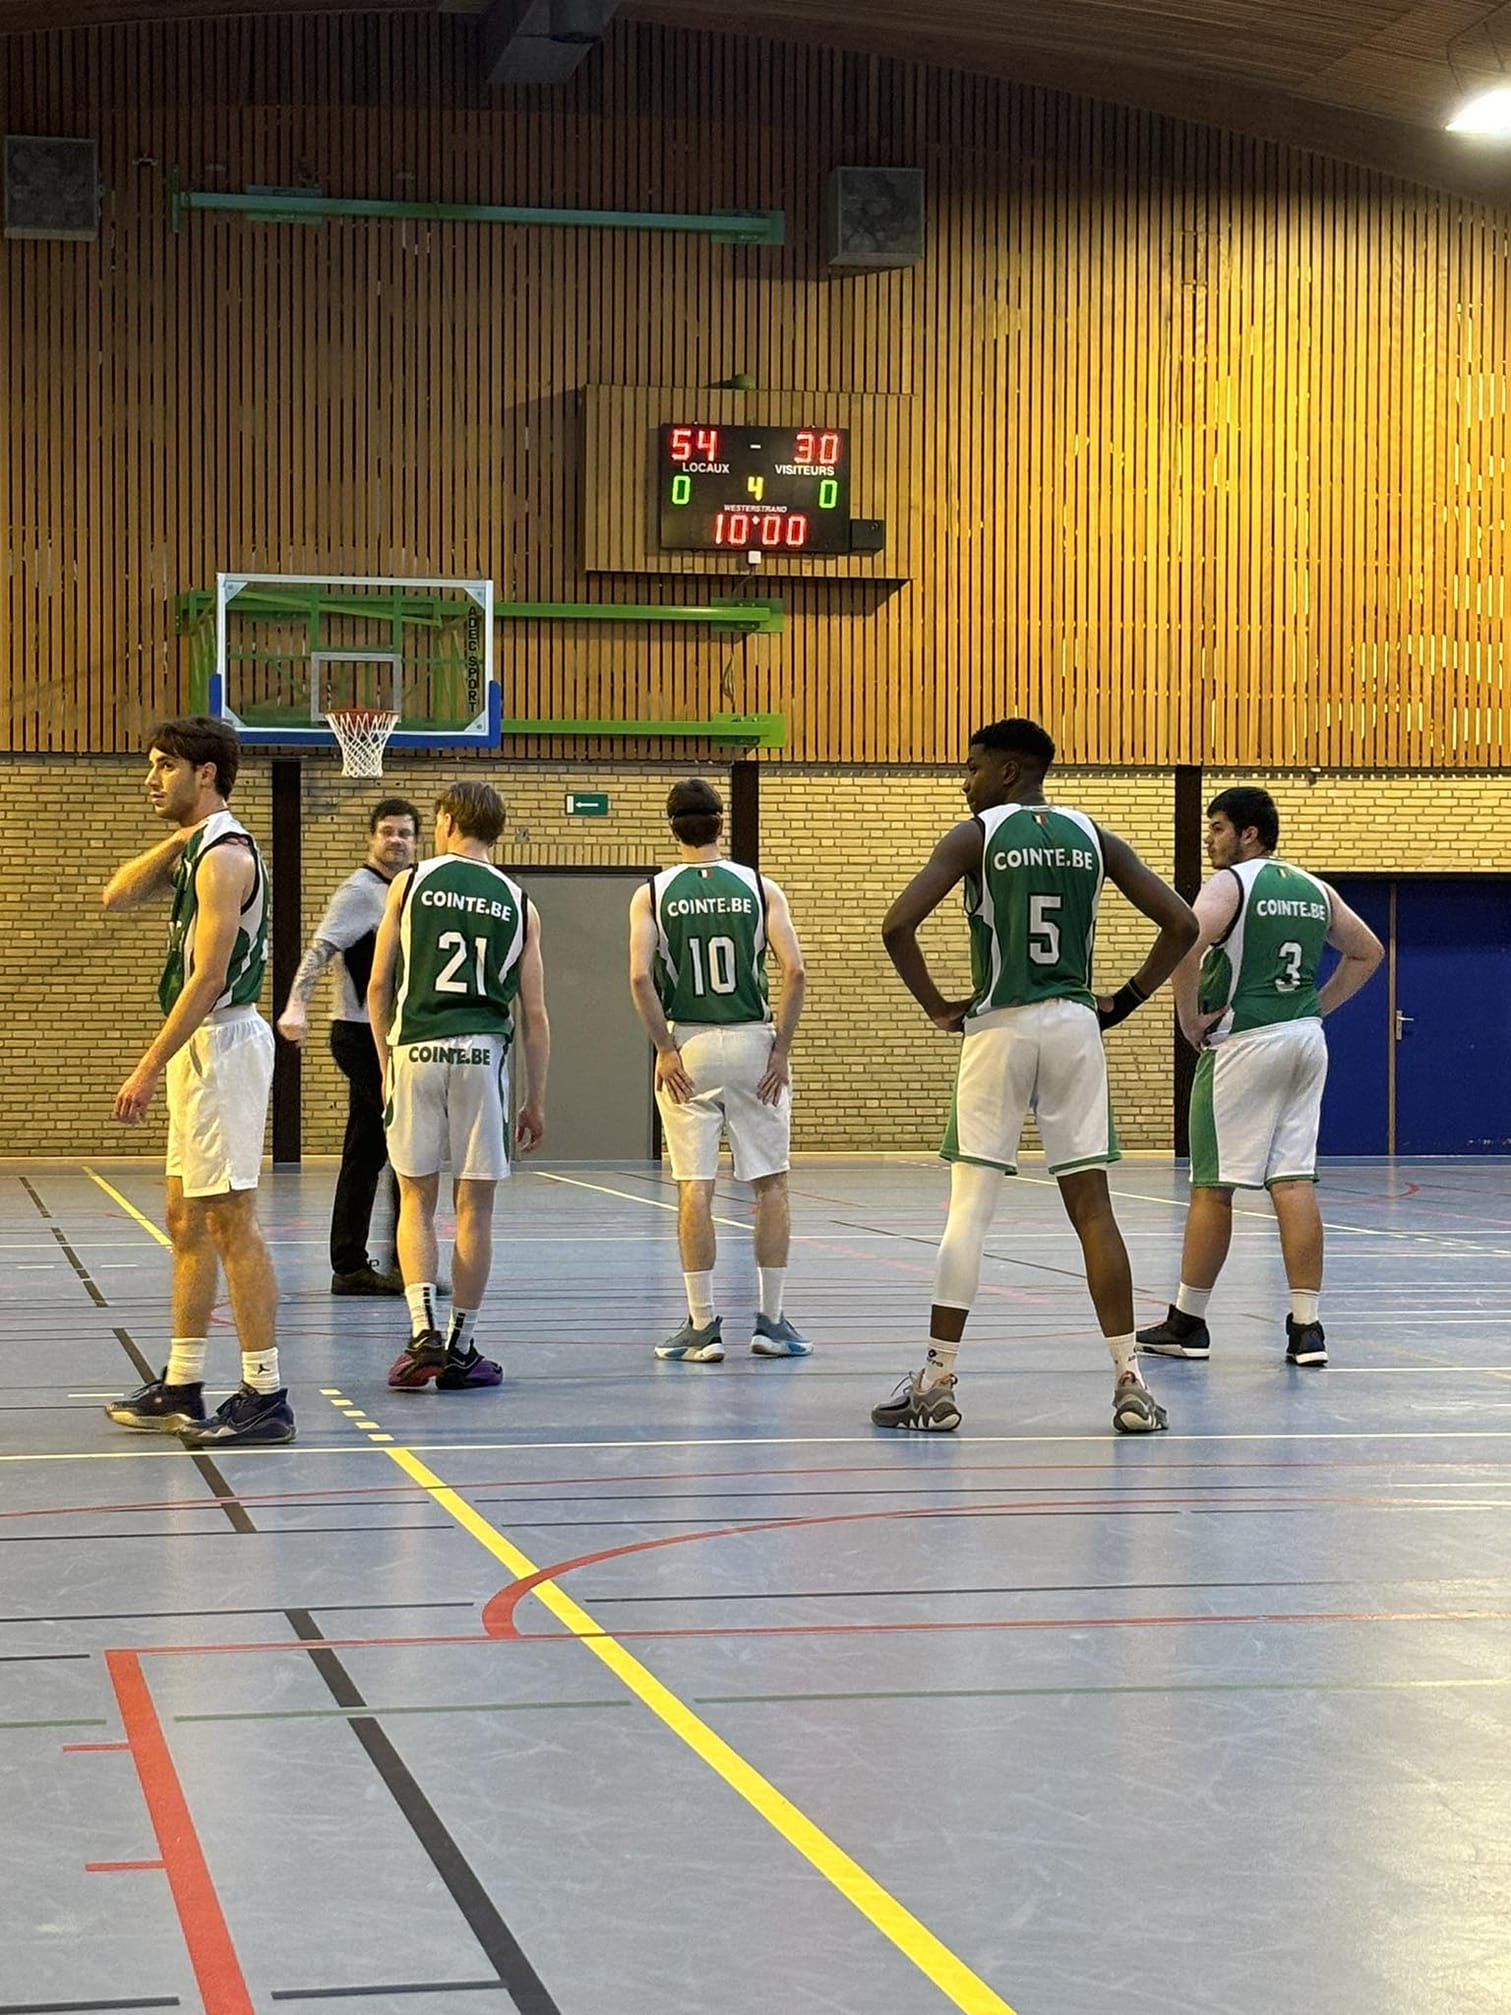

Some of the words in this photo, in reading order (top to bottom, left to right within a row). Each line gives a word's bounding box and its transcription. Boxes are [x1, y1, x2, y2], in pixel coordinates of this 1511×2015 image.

[671, 429, 718, 462] 54
[793, 432, 839, 465] 30
[682, 462, 730, 474] LOCAUX
[775, 464, 835, 476] VISITEURS
[671, 475, 691, 505] 0
[747, 476, 764, 501] 4
[818, 479, 838, 509] 0
[724, 504, 788, 513] WESTERSTRAND
[468, 606, 477, 652] ADEC
[468, 656, 477, 713] SPORT
[993, 848, 1093, 871] COINTE.BE
[421, 890, 513, 922] COINTE.BE
[667, 897, 752, 917] COINTE.BE
[1256, 899, 1326, 921] COINTE.BE
[1029, 895, 1062, 964] 5
[435, 931, 488, 997] 21
[689, 936, 737, 996] 10
[1275, 942, 1303, 993] 3
[408, 1046, 491, 1066] COINTE.BE
